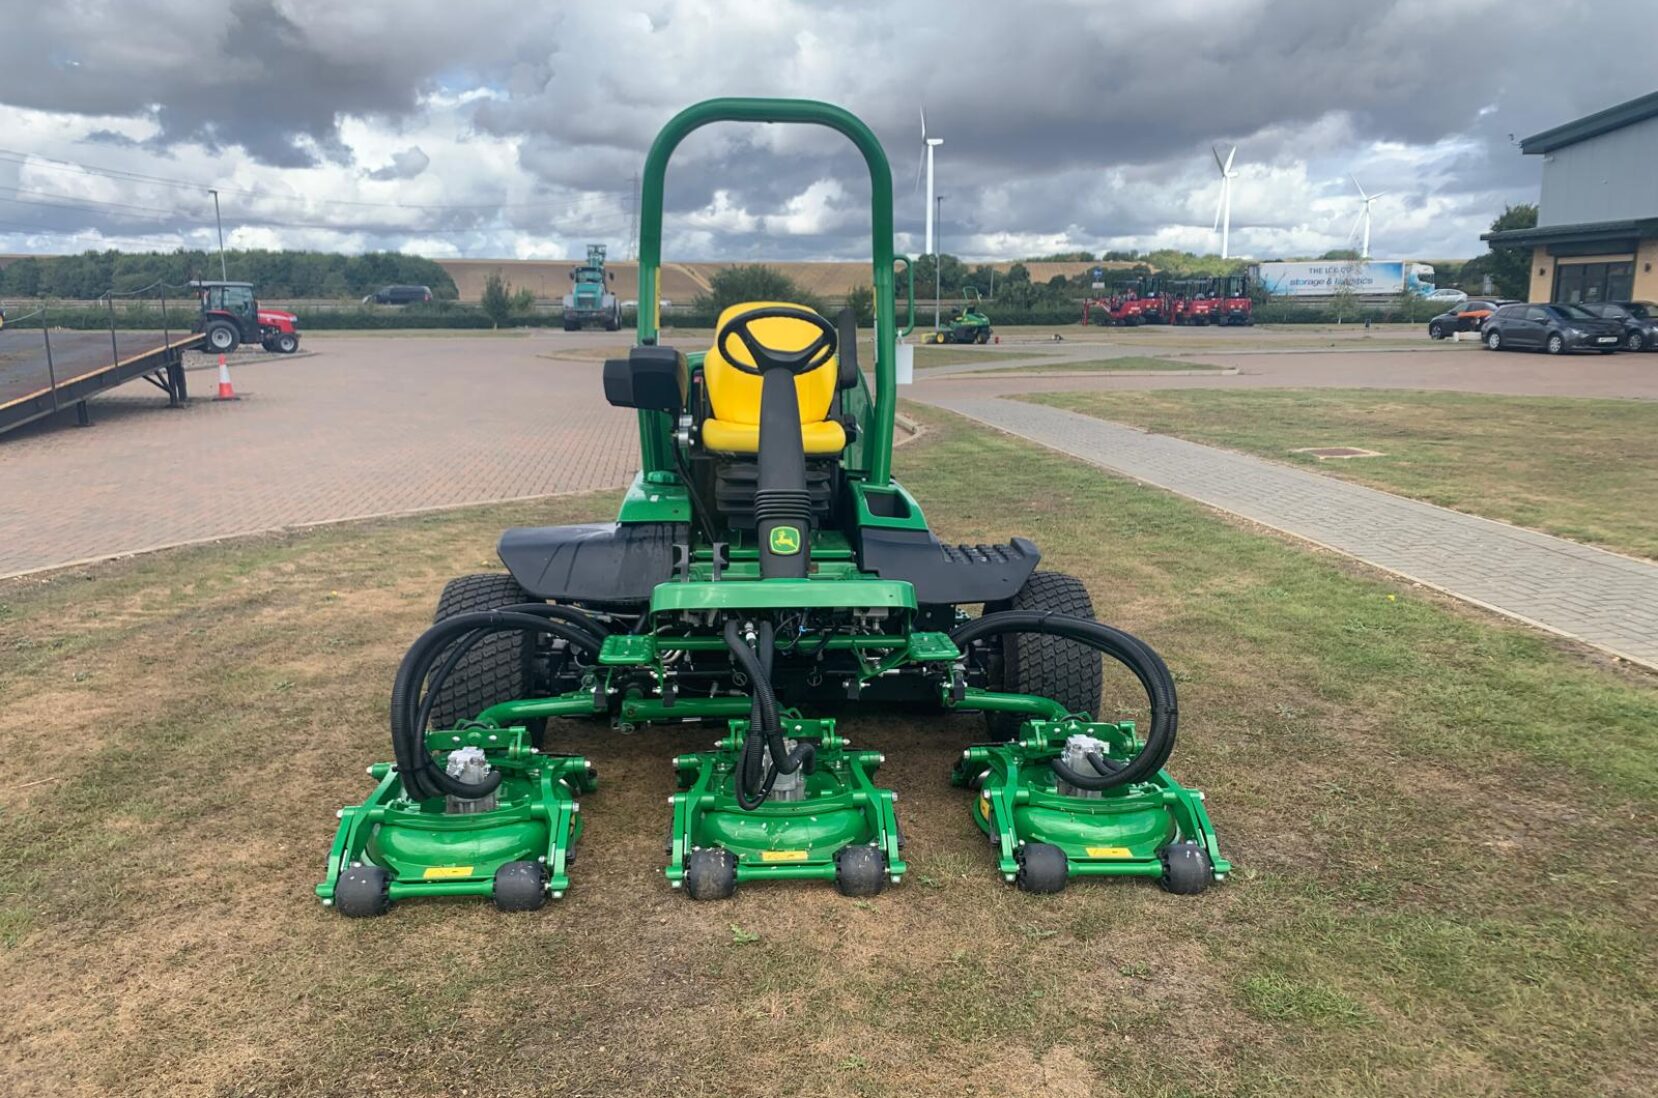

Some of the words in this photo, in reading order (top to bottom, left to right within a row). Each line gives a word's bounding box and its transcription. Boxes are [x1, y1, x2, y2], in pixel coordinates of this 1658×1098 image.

[1309, 267, 1322, 275] THE
[1290, 278, 1324, 287] storage
[1326, 277, 1332, 285] &
[1334, 277, 1373, 286] loistics
